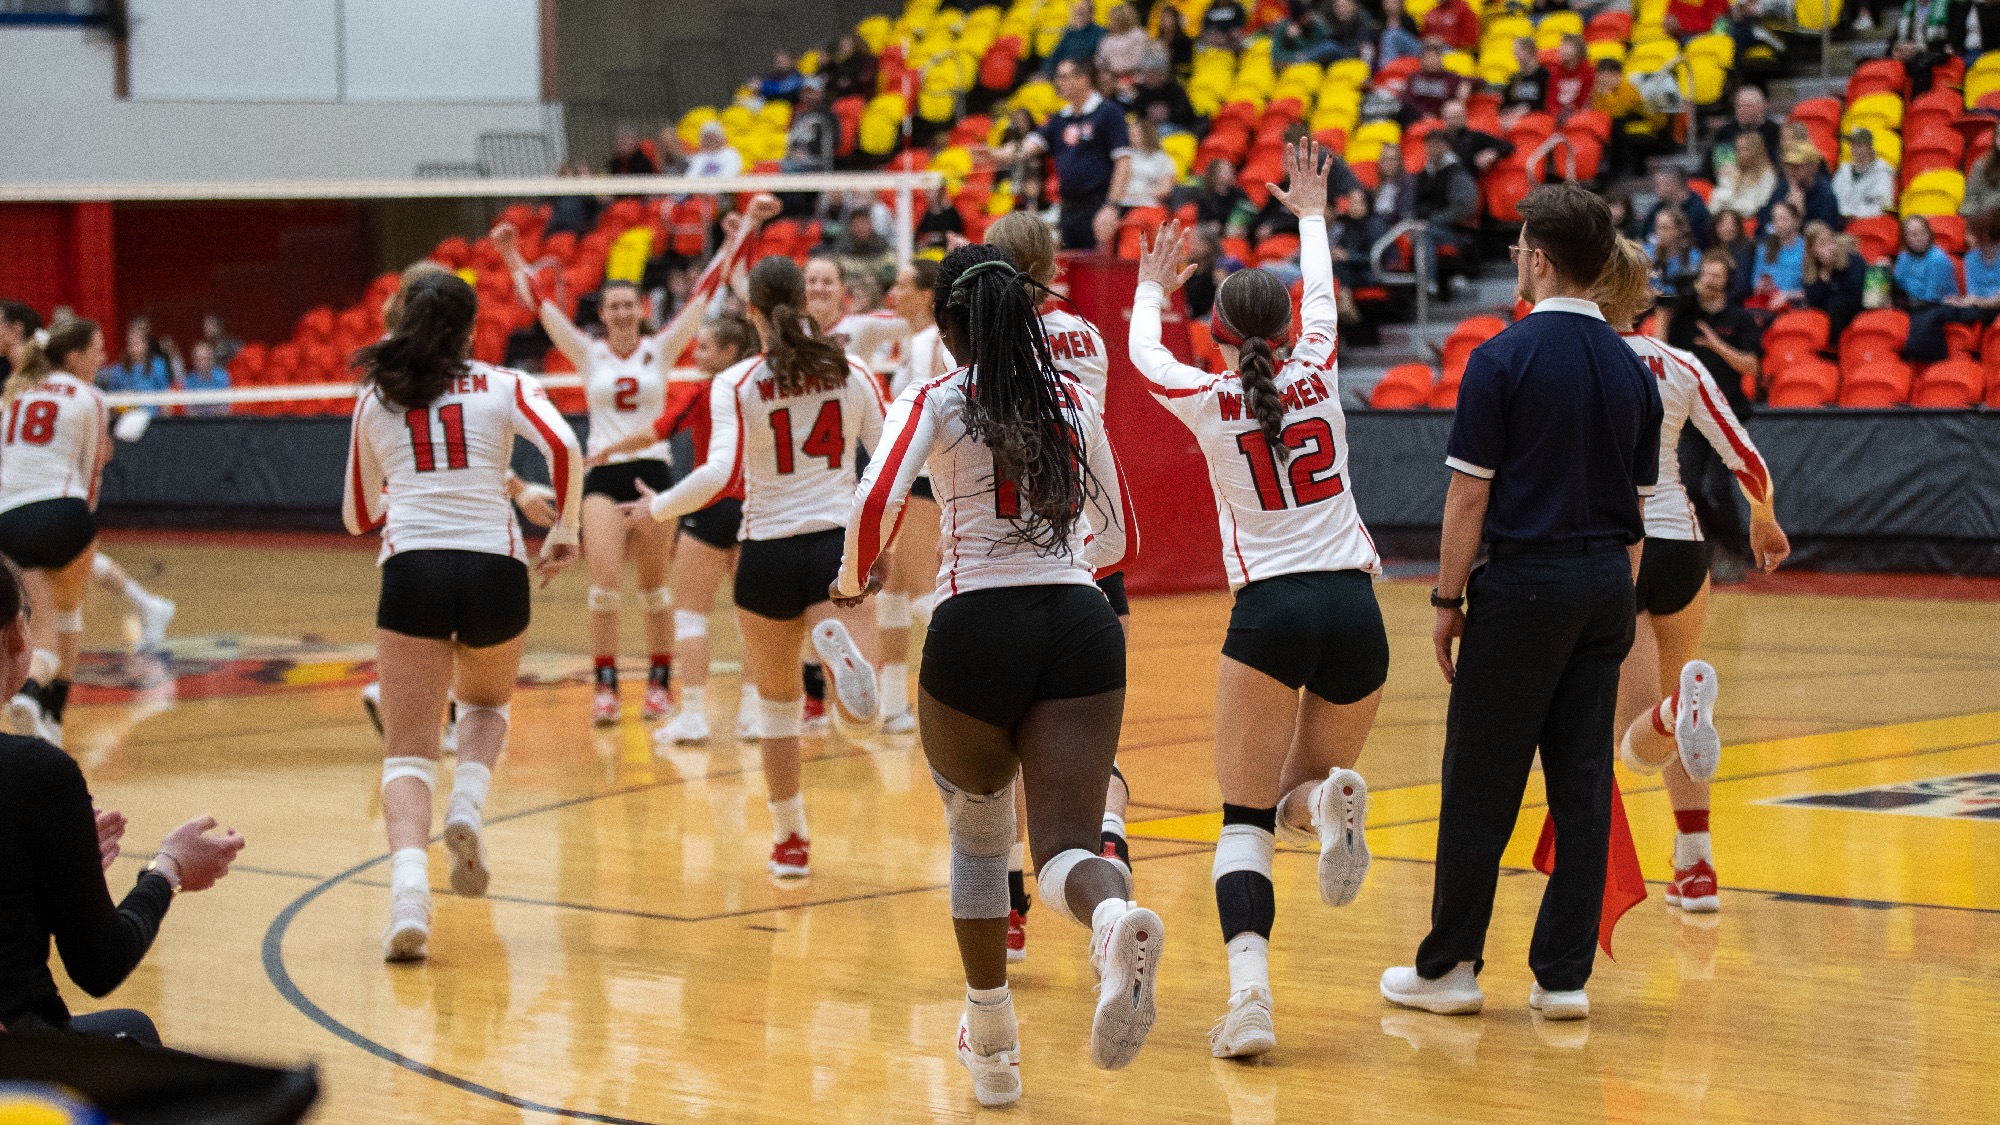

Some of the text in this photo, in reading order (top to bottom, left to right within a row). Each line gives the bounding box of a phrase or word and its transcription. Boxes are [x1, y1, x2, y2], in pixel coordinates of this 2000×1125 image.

[1042, 331, 1098, 360] MEN
[614, 376, 639, 413] 2
[1217, 373, 1330, 421] WMEN
[6, 399, 58, 446] 18
[405, 403, 469, 473] 11
[769, 398, 845, 474] 14
[1236, 416, 1344, 511] 12
